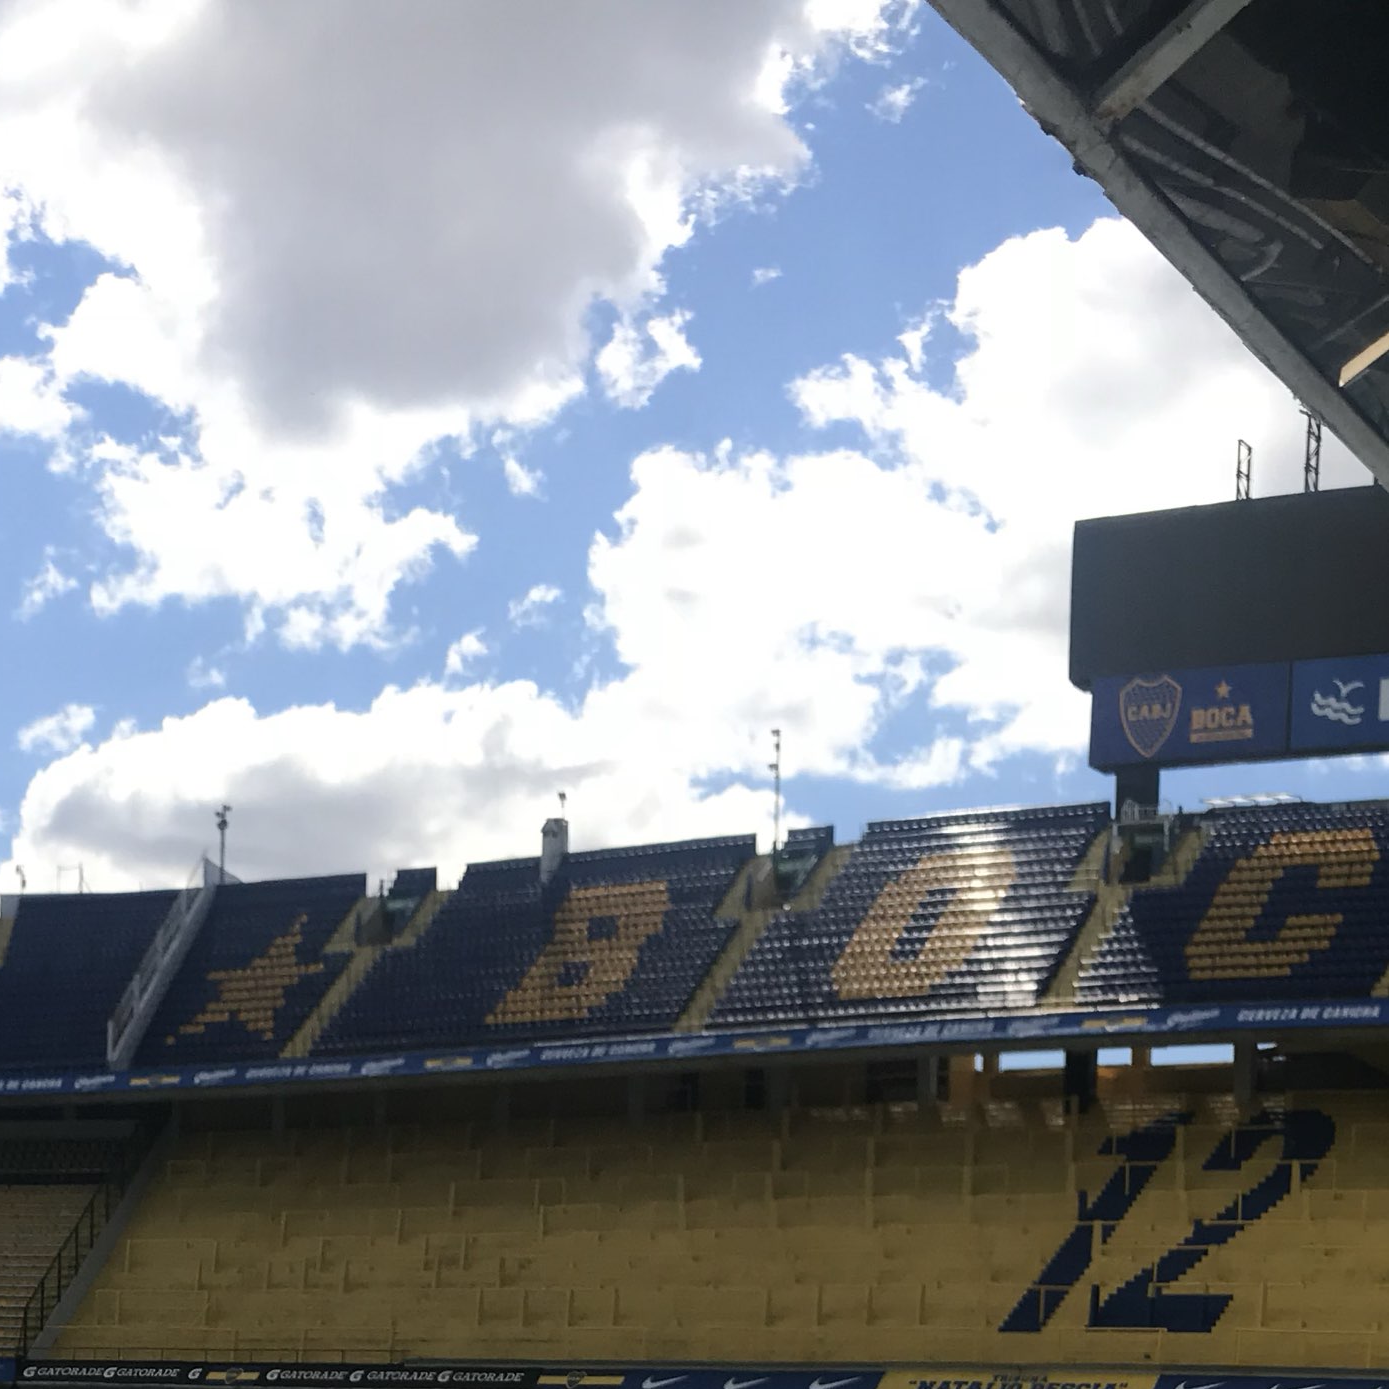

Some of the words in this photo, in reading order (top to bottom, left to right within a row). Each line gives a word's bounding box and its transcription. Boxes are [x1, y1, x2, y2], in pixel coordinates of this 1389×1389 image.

[1190, 704, 1254, 730] BOCA
[998, 1108, 1335, 1333] 12
[37, 1367, 104, 1376] GATORADE
[117, 1368, 180, 1377] GATORADE
[280, 1370, 348, 1380] GATORADE
[367, 1371, 437, 1381] GATORADE
[453, 1372, 524, 1382] GATORADE
